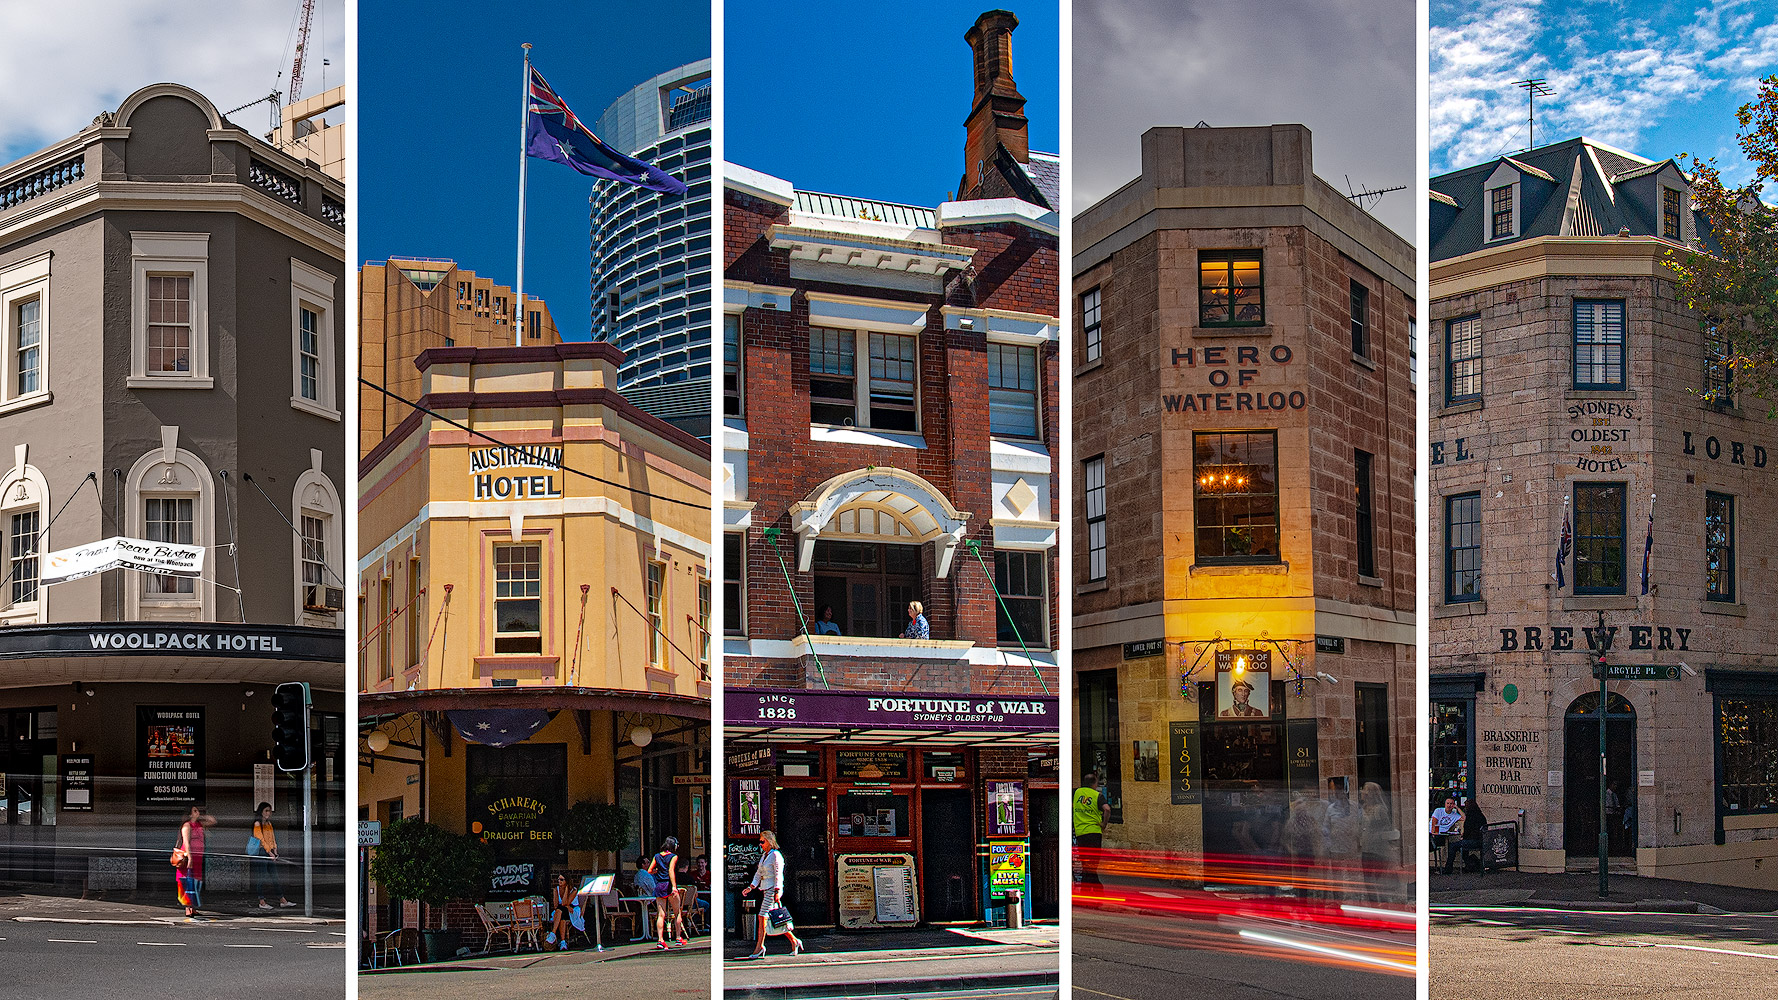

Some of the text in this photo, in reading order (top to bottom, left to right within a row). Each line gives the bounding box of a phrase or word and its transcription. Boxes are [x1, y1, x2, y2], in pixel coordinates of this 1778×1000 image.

[1171, 345, 1293, 368] HERO
[1208, 369, 1260, 389] OF
[1162, 391, 1307, 414] WATERLOO
[1567, 402, 1633, 419] SYDNEY'S
[1571, 429, 1630, 442] OLDEST
[1682, 430, 1768, 468] LORD
[469, 446, 564, 475] AUSTRALIAN
[1575, 456, 1627, 472] HOTEL
[474, 475, 562, 500] HOTEL
[113, 540, 151, 553] Bear
[153, 546, 197, 560] Bistro
[166, 558, 194, 567] Woolpack
[88, 633, 283, 652] WOOLPACK HOTEL
[1499, 625, 1692, 651] BREWERY
[1132, 640, 1162, 652] LOWER FORT ST
[1608, 666, 1656, 675] ARGYLE PL
[758, 695, 796, 705] SINCE
[867, 698, 1046, 714] FORTUNE of WAR
[758, 707, 797, 719] 1828
[913, 713, 1004, 722] SYDNEY'S OLDEST PUB
[1483, 730, 1540, 742] BRASSERIE
[1296, 747, 1310, 758] 81
[1503, 744, 1528, 752] FLOOR
[728, 752, 751, 765] FORTUNE
[758, 747, 772, 759] WAR
[1486, 756, 1534, 768] BREWERY
[149, 761, 192, 769] FREE PRIVATE
[143, 771, 198, 780] FUNCTION ROOM
[1500, 770, 1521, 781] BAR
[153, 785, 188, 793] 9635 8043
[1481, 784, 1542, 795] ACCOMMODATION
[487, 796, 547, 815] SCHARER'S
[1076, 796, 1092, 805] AVS
[498, 812, 537, 820] BAVARIAN
[505, 820, 530, 828] STYLE
[483, 830, 553, 840] DRAUGHT BEER
[991, 845, 1006, 853] FOX
[991, 854, 1009, 864] LIVE
